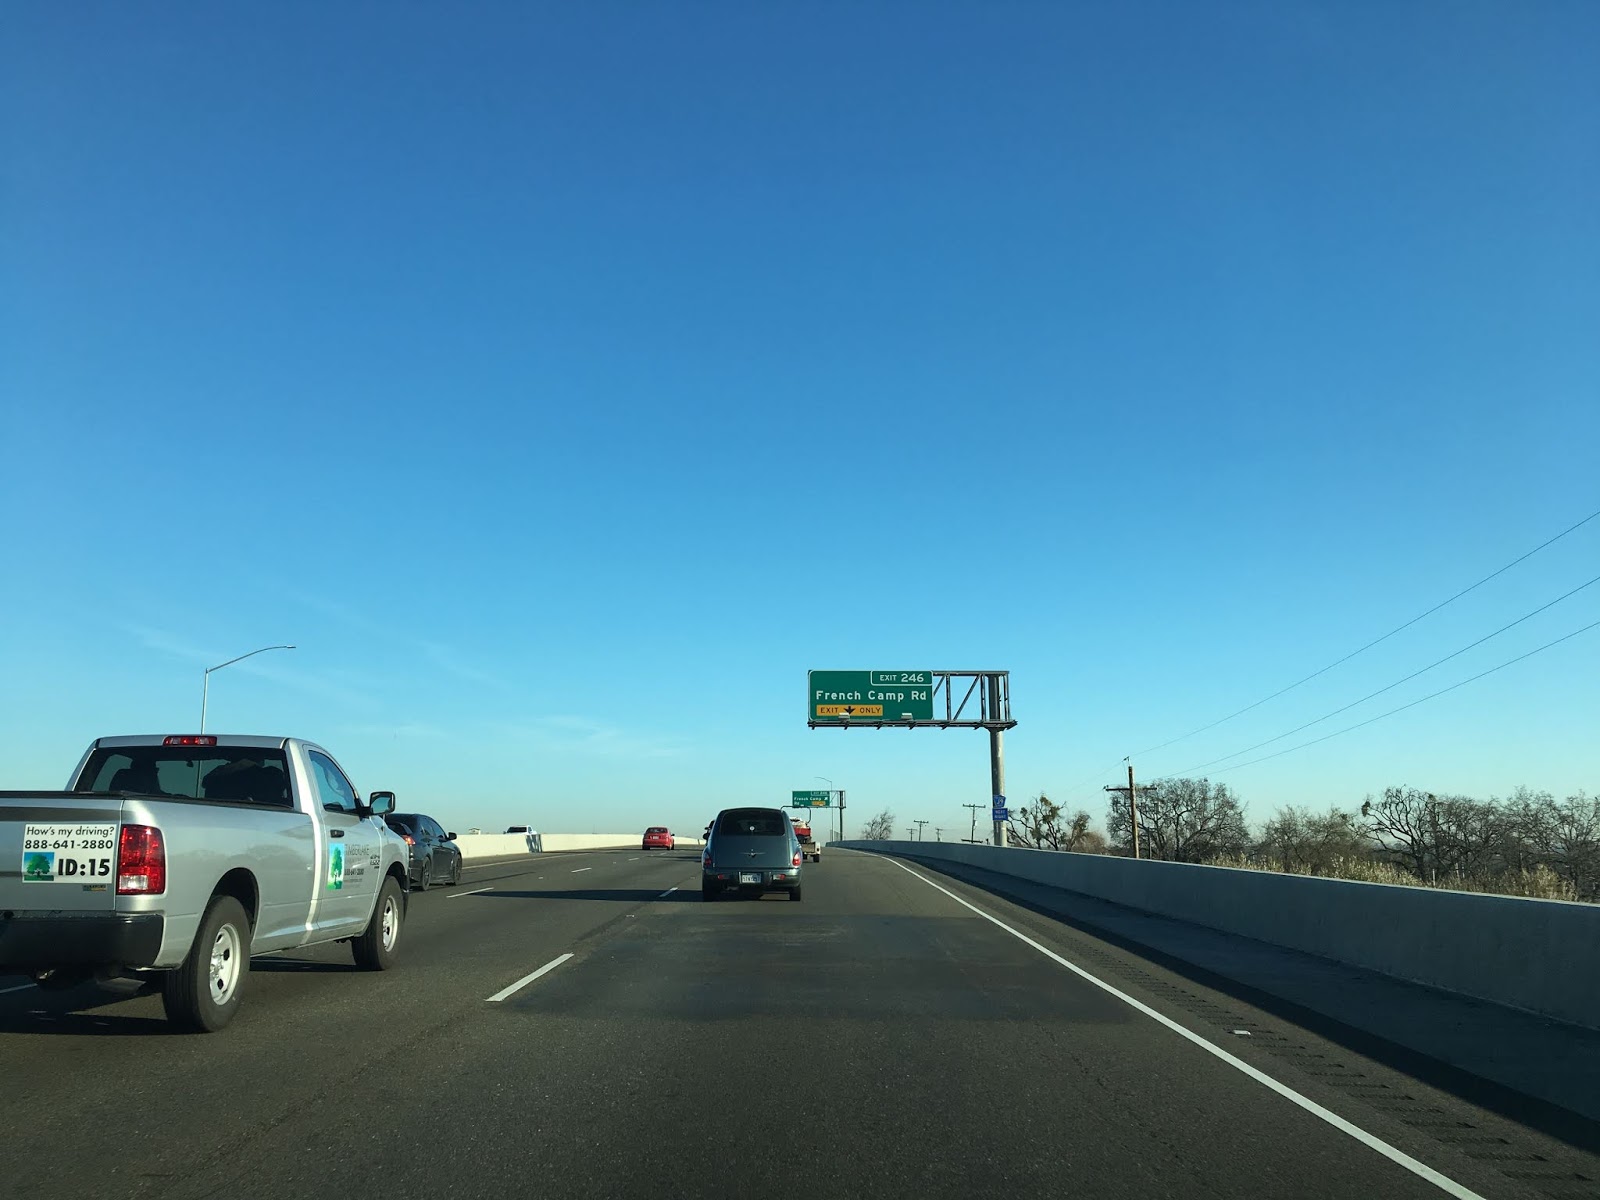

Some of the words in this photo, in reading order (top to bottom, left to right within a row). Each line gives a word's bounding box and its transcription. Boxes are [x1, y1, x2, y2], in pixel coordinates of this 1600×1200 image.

[879, 674, 897, 682] EXIT
[900, 673, 924, 683] 246
[815, 690, 861, 701] French
[867, 690, 905, 703] Camp
[911, 690, 927, 701] Rd
[26, 826, 55, 836] How's
[59, 827, 73, 838] my
[75, 826, 115, 837] driving?
[24, 839, 114, 850] 888-641-2880
[57, 858, 110, 877] ID:15
